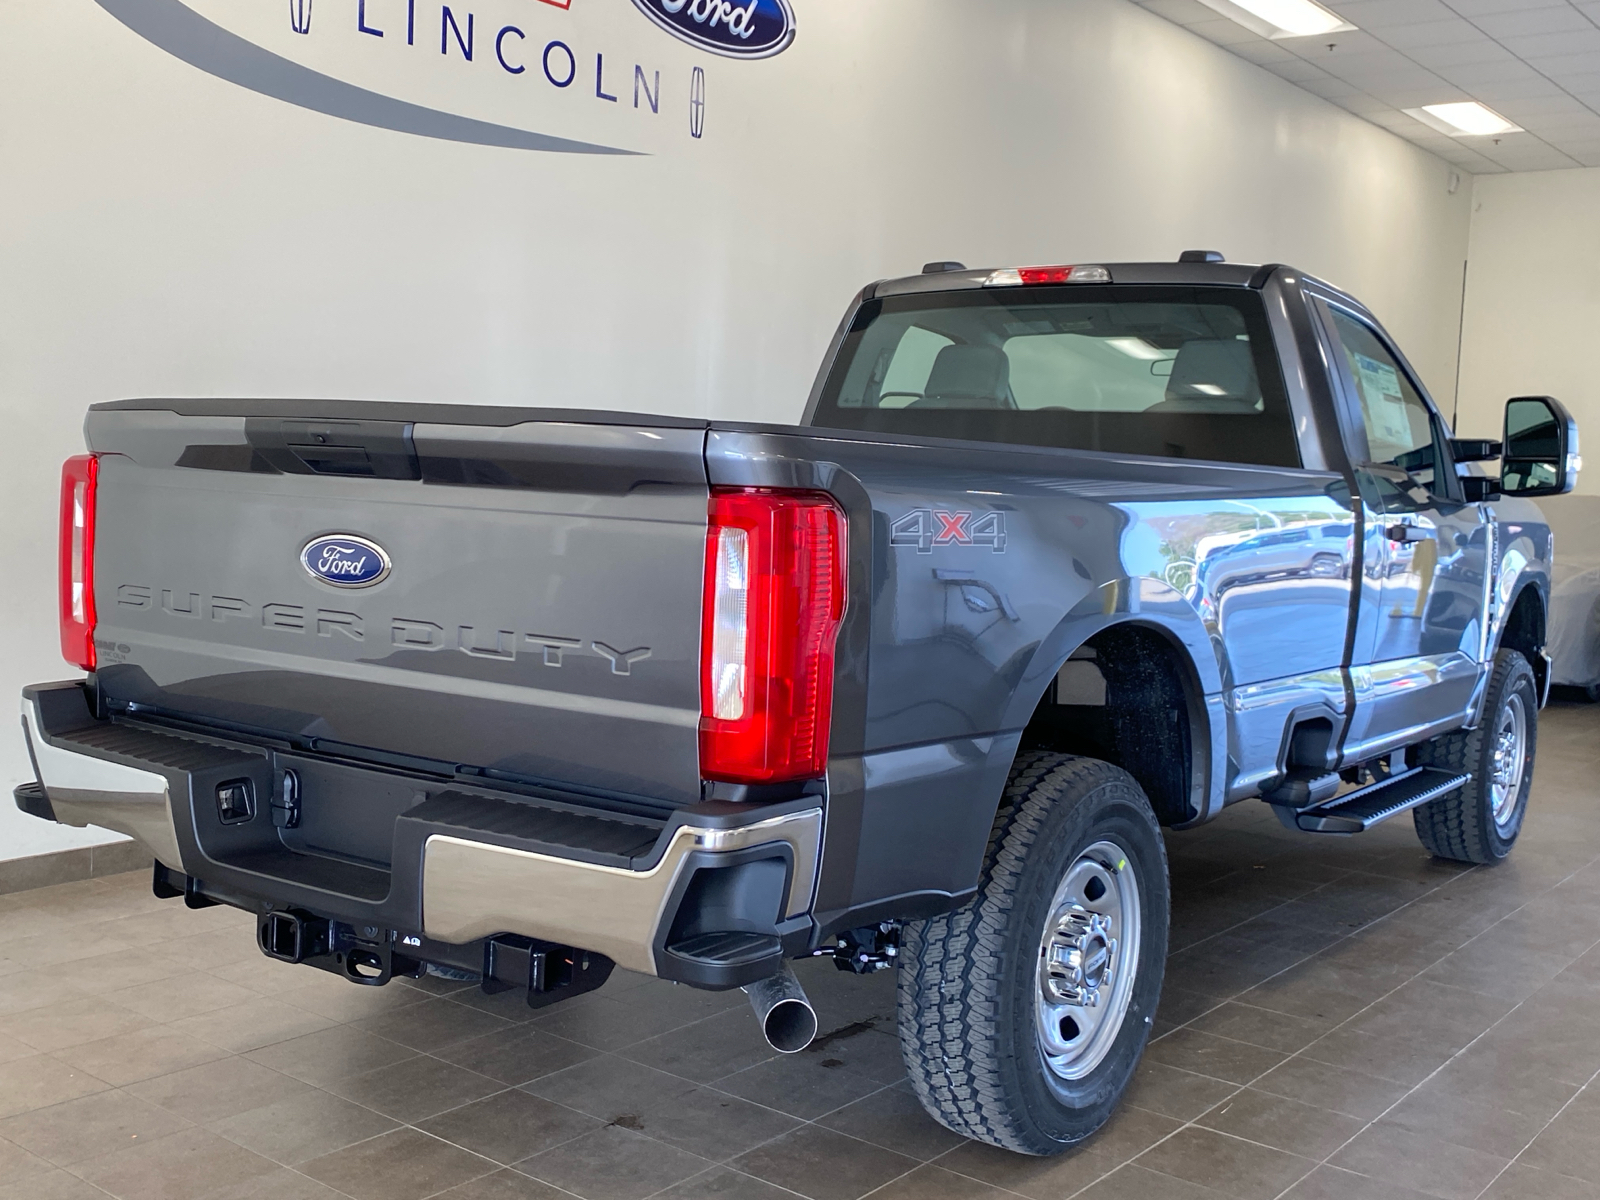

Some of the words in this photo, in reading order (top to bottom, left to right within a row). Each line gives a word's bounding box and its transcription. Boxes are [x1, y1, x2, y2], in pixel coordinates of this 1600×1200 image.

[358, 0, 660, 114] LINCOLN
[318, 545, 367, 576] Ford
[117, 584, 365, 642] SUPER
[391, 617, 653, 676] DUTY
